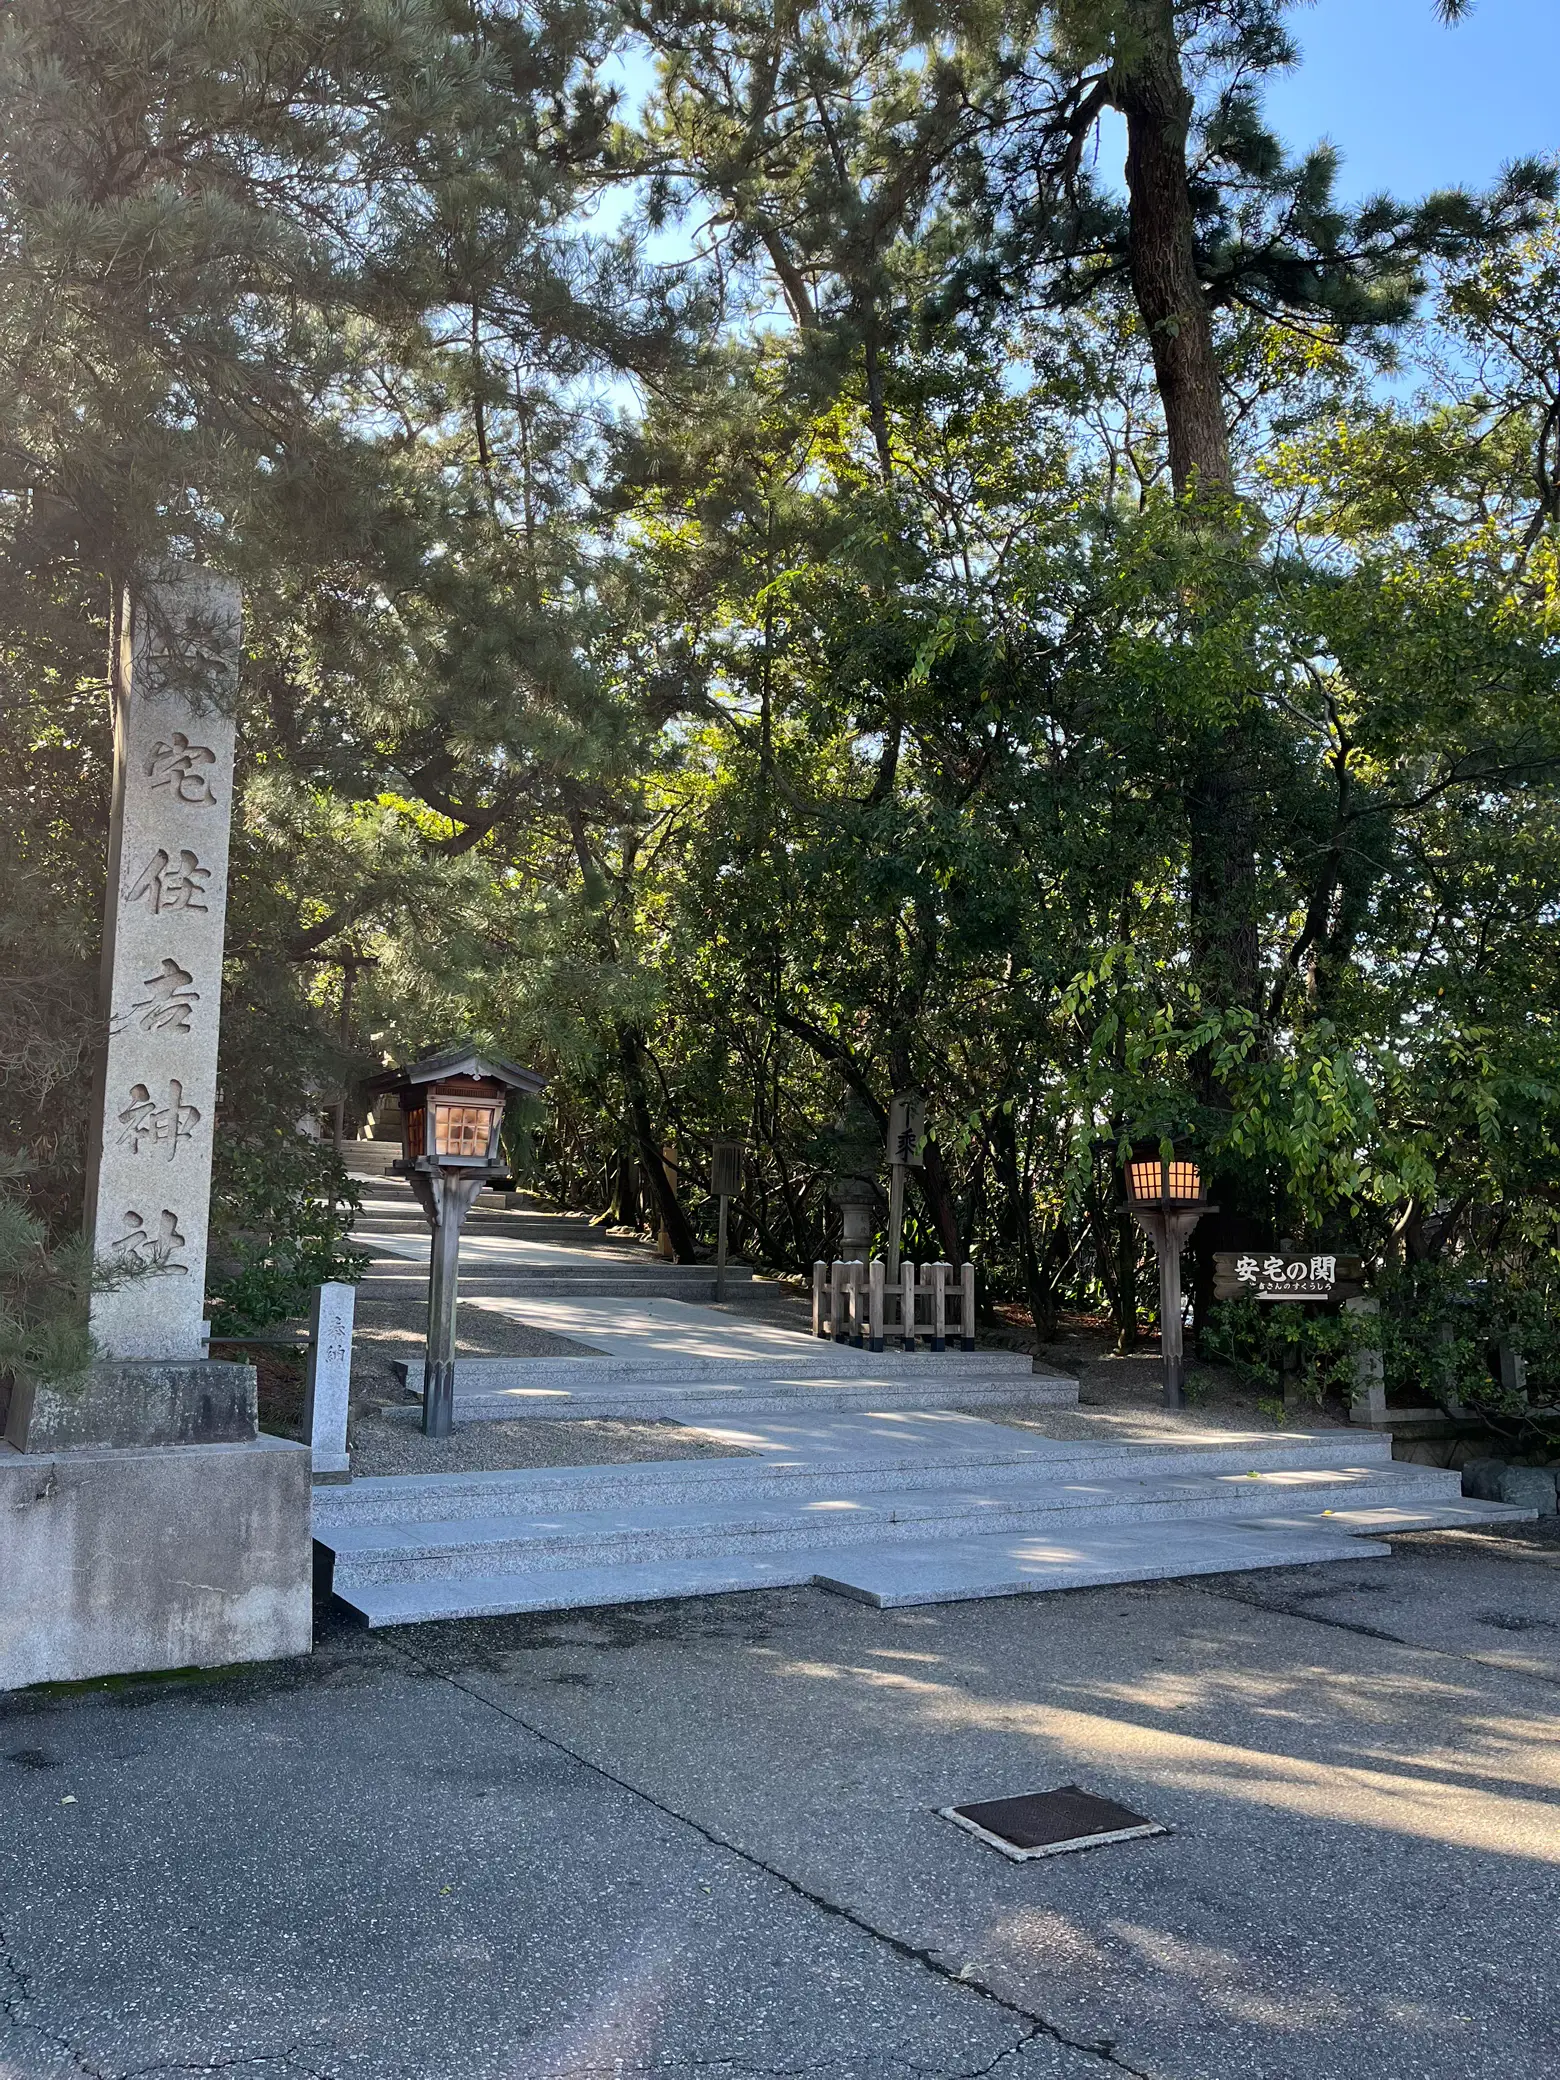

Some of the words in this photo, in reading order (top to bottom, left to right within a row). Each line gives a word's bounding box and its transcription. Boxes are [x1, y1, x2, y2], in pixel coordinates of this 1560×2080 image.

[1234, 1255, 1337, 1284] 安宅の関
[325, 1316, 346, 1363] 奉納
